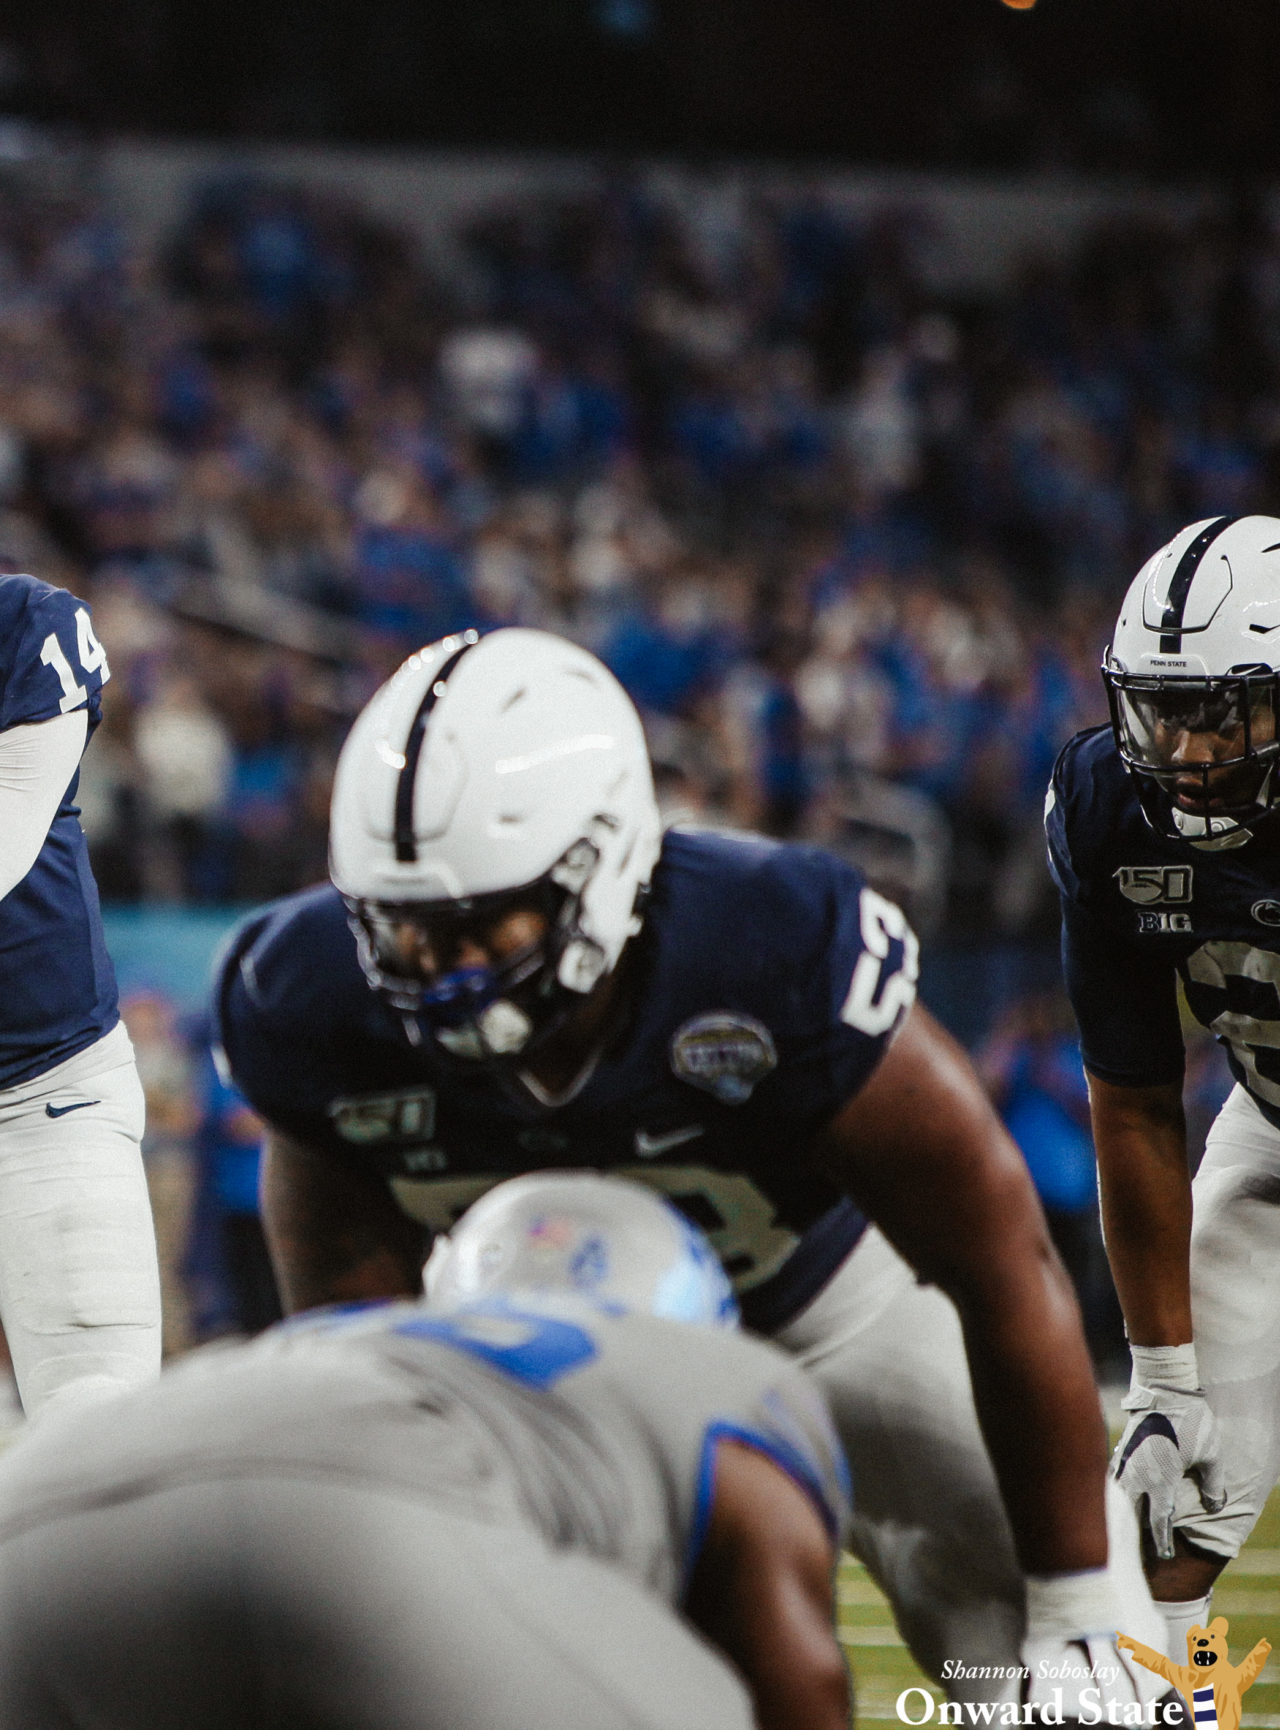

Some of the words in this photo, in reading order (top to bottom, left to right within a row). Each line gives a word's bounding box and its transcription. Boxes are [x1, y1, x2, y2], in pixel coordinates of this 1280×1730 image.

[40, 607, 111, 714] 14
[1150, 659, 1166, 667] PENN
[1167, 660, 1187, 668] STATE
[1112, 865, 1193, 905] 150
